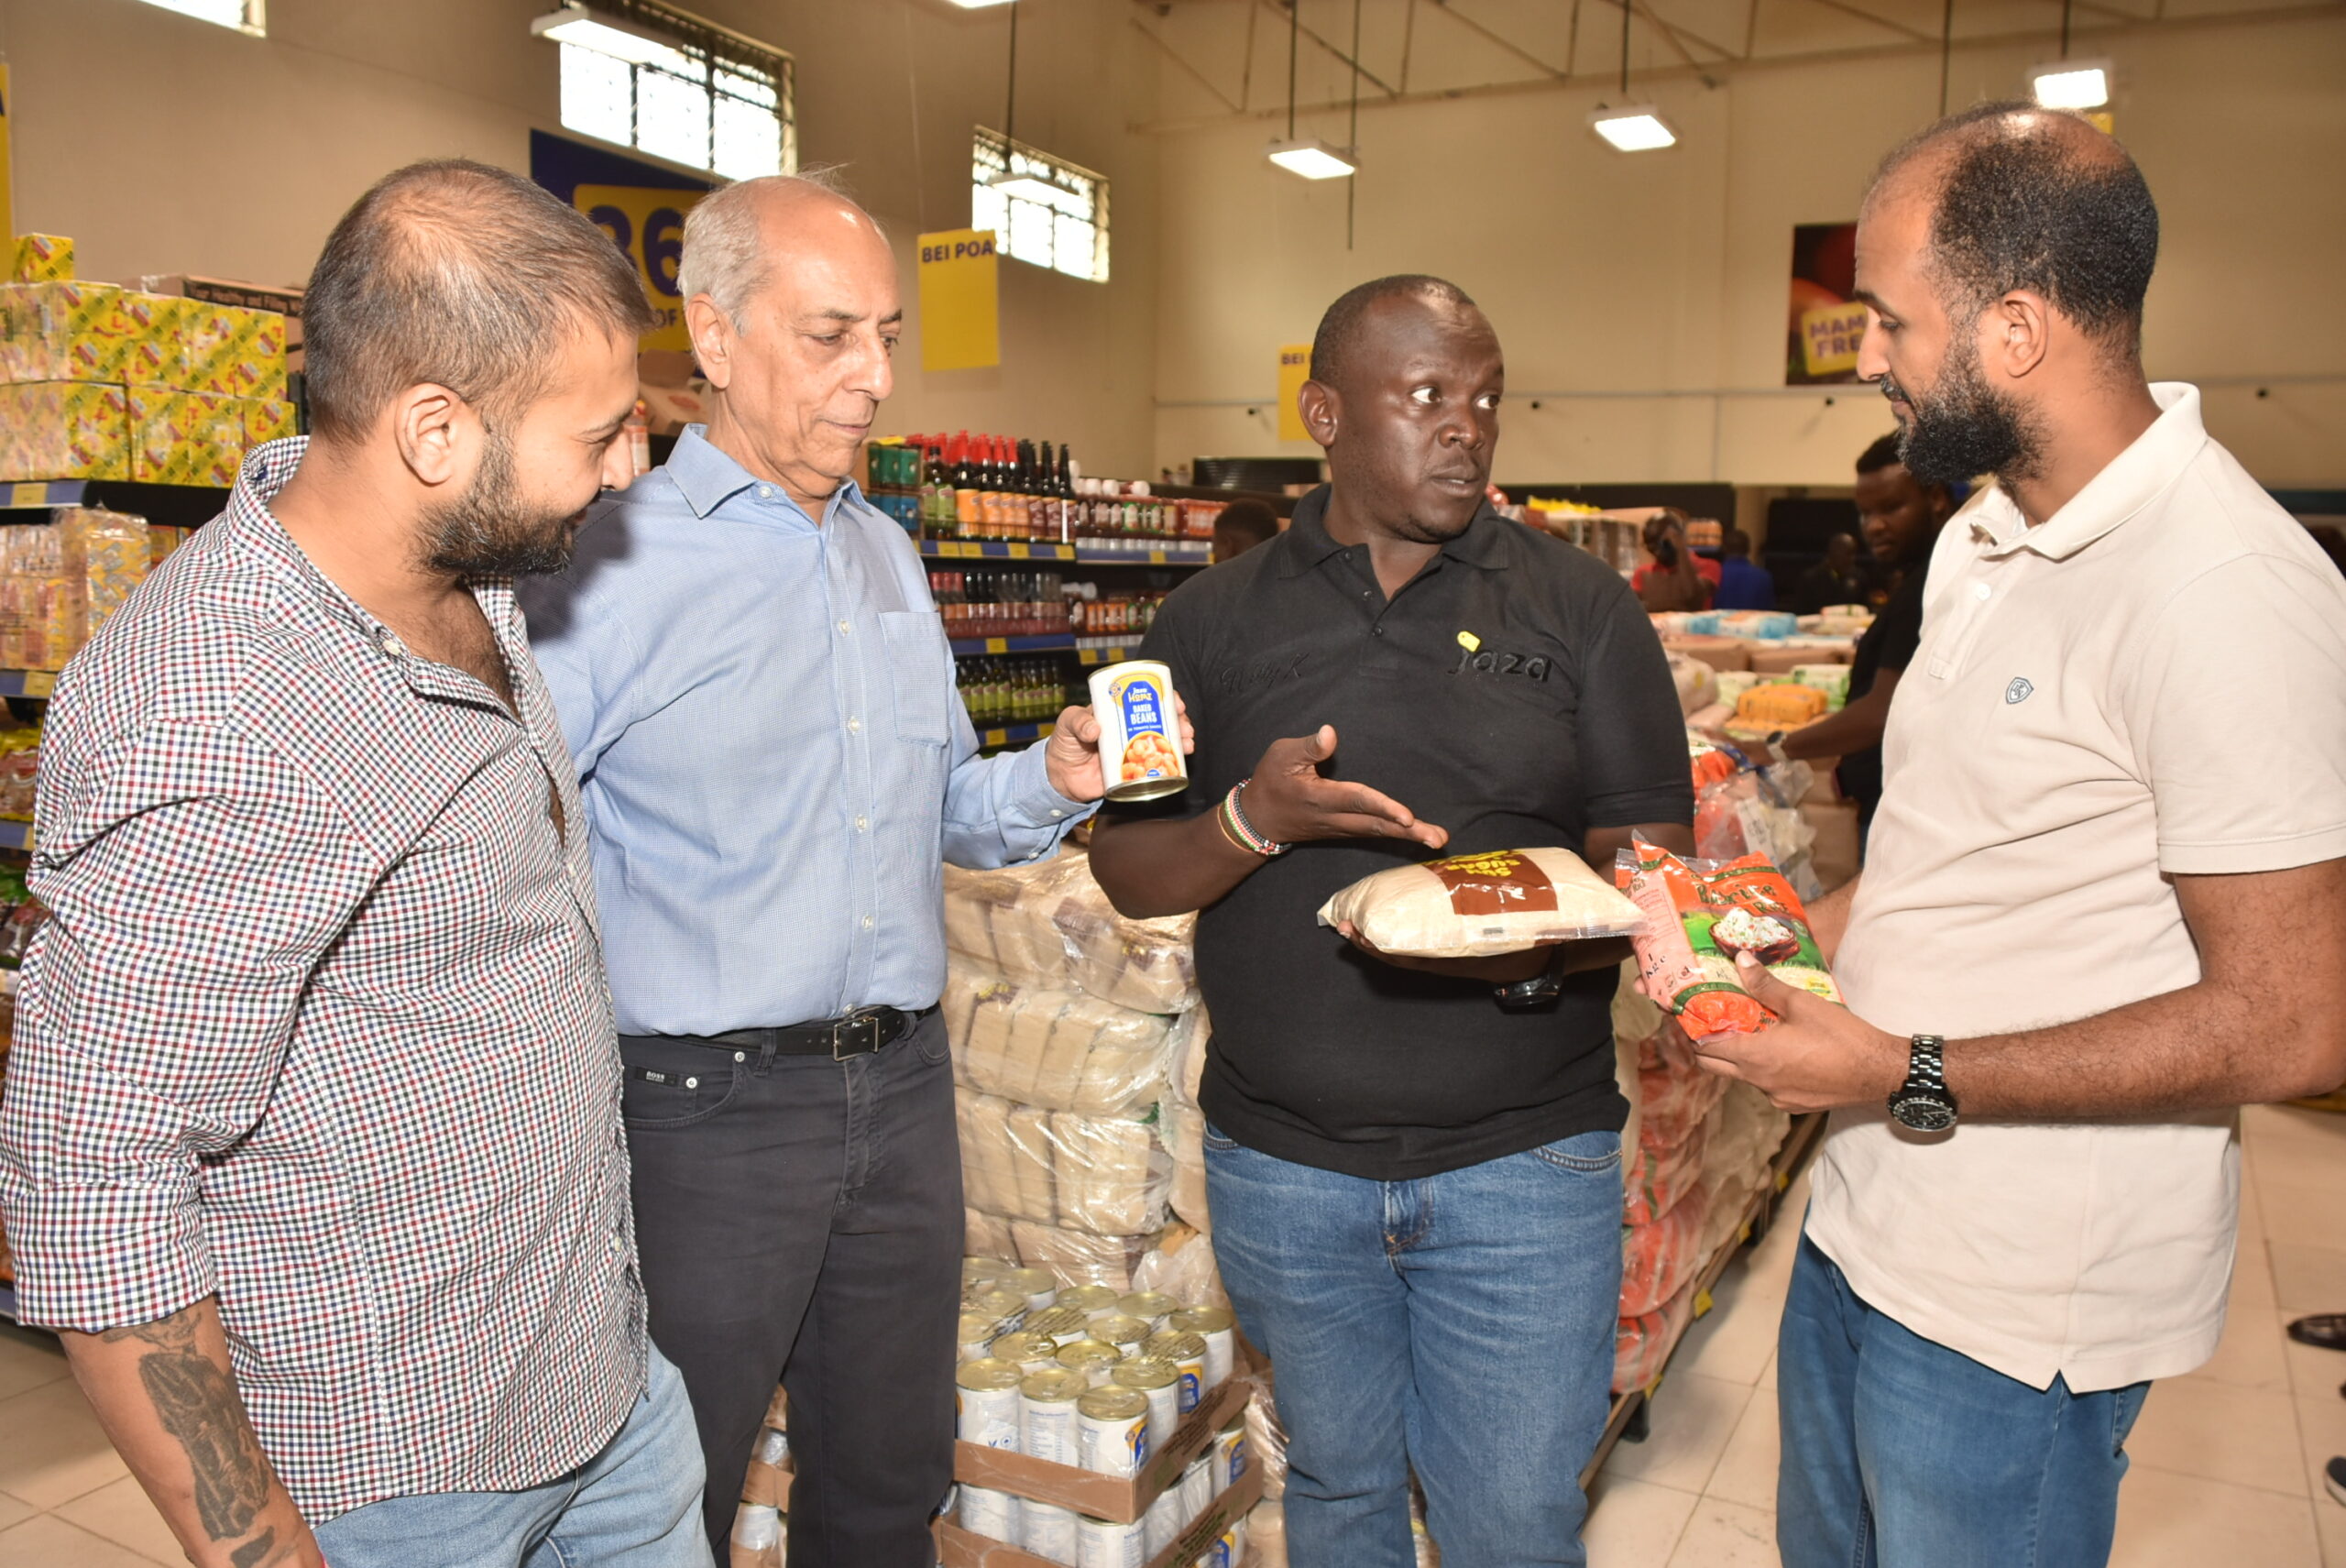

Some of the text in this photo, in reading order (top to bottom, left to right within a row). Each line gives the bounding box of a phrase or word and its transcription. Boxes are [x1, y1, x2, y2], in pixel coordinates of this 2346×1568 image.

[922, 238, 993, 263] BEI POA
[1133, 704, 1152, 713] BAKED
[1130, 712, 1157, 725] BEANS
